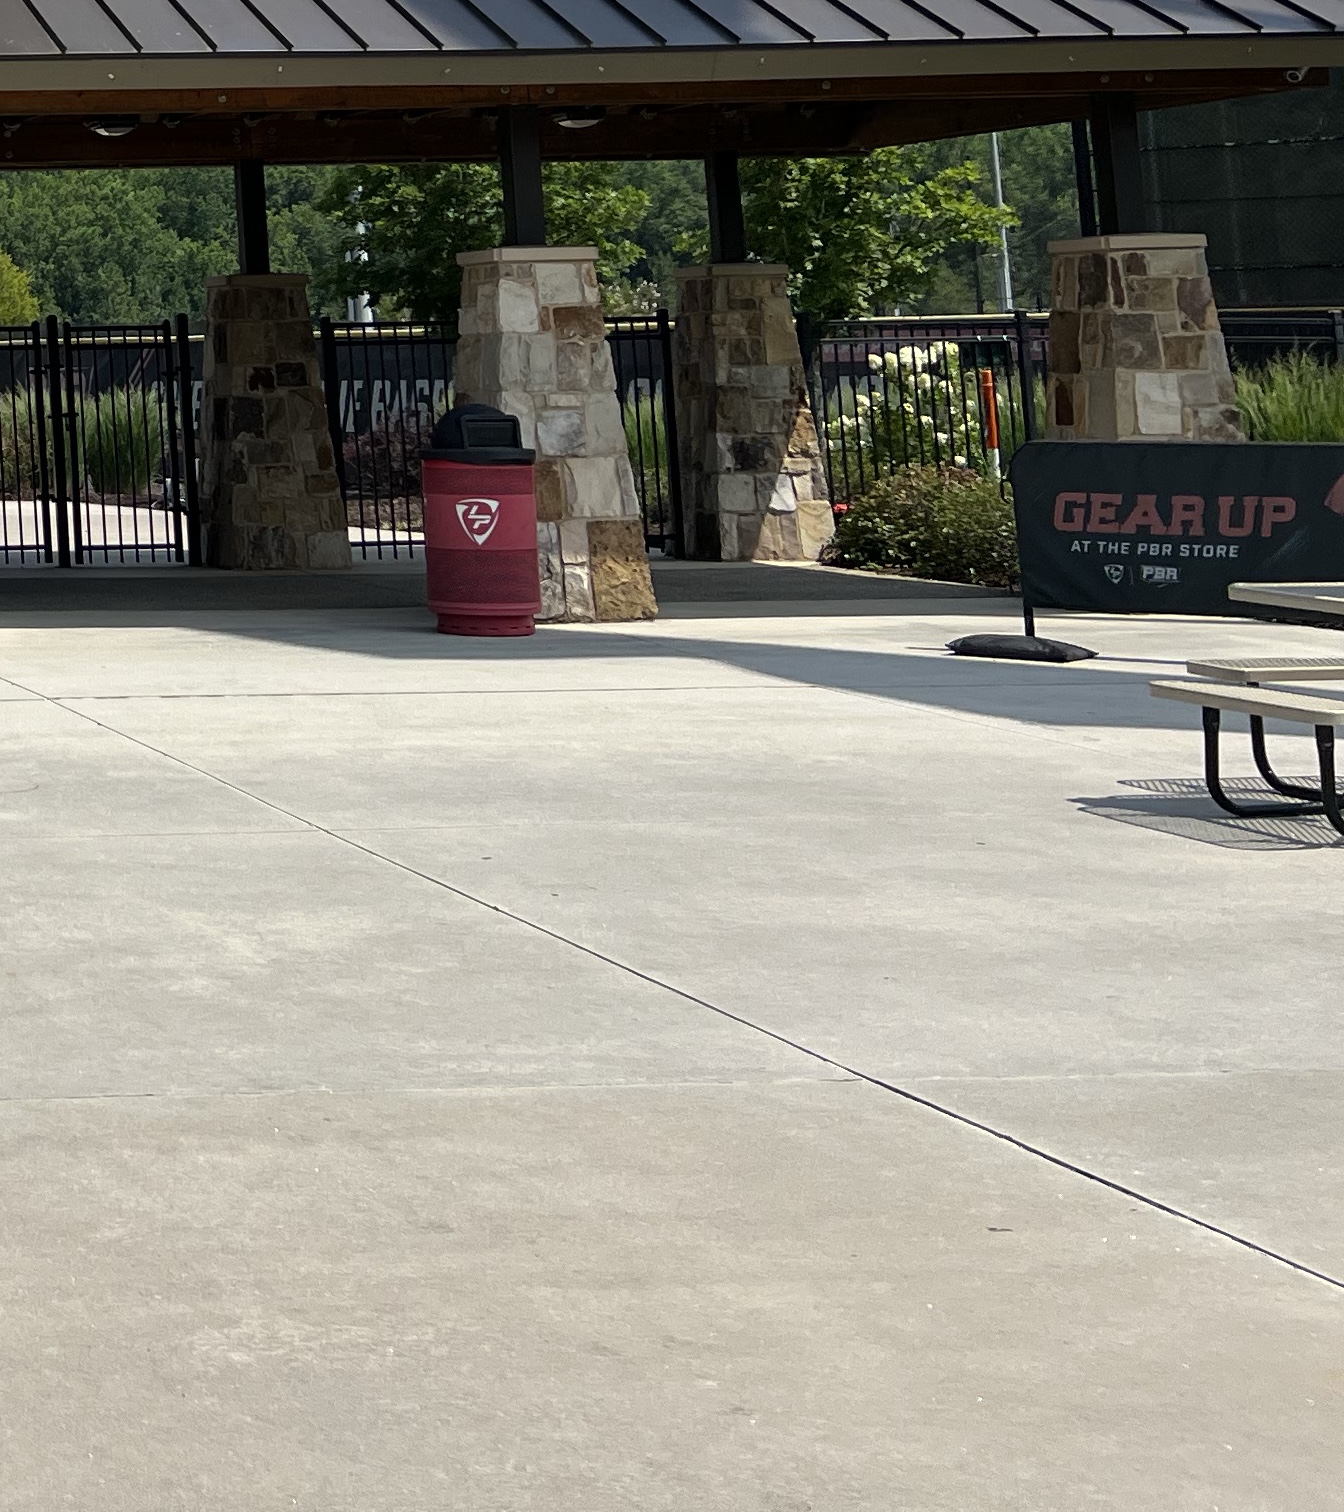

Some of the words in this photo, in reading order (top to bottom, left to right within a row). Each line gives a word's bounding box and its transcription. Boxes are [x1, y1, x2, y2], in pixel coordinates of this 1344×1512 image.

[1053, 492, 1206, 536] GEAR
[1217, 495, 1297, 538] UP
[1070, 540, 1091, 553] AT
[1097, 541, 1131, 555] THE
[1137, 543, 1172, 556] PBR
[1179, 544, 1239, 558] STORE
[1142, 567, 1178, 580] PBR
